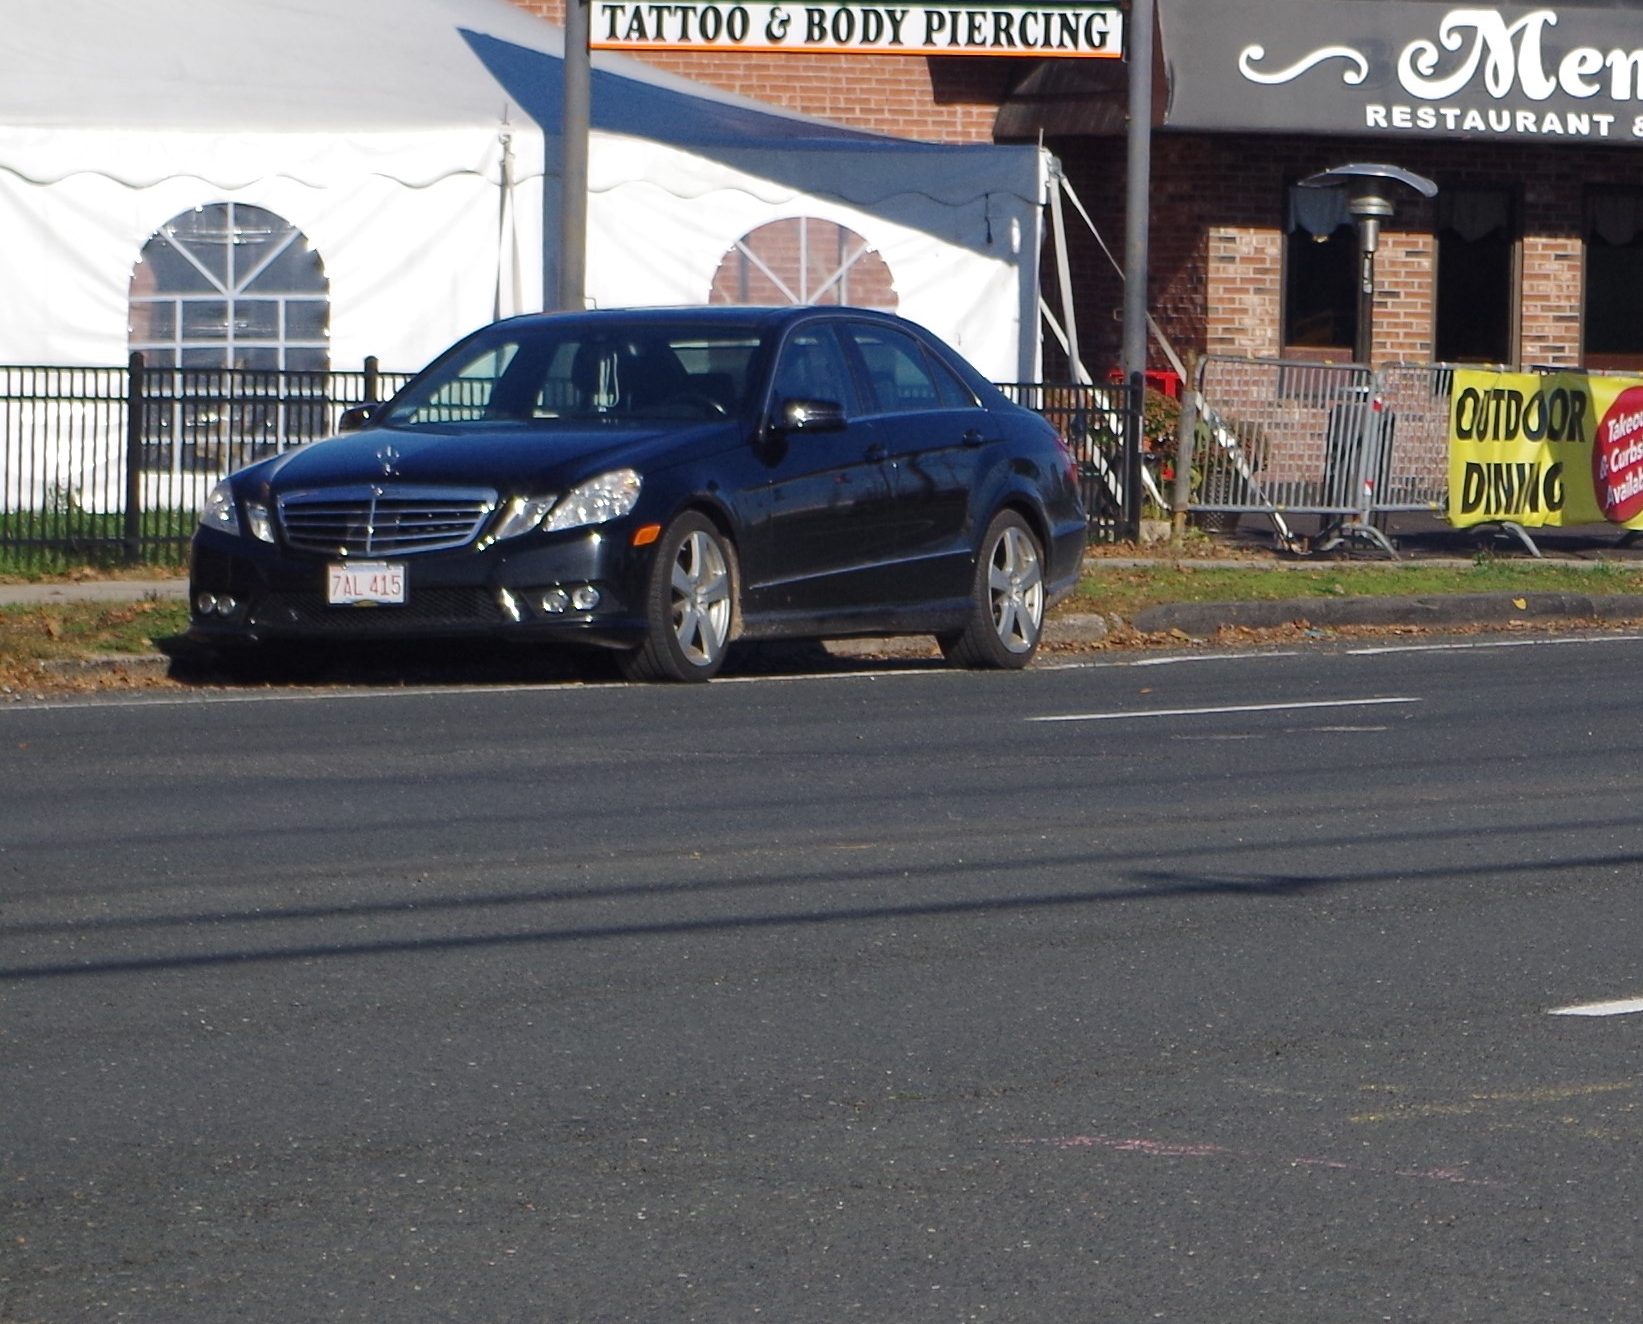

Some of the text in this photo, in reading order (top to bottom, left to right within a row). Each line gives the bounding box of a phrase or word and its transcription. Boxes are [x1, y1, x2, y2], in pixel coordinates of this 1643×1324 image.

[602, 4, 1110, 50] TATTOO & BODY PIERCING
[1366, 104, 1614, 137] RESTAURANT
[1456, 387, 1587, 443] OUTDOOR
[1600, 454, 1609, 480] &
[1461, 461, 1565, 515] DINING
[332, 575, 401, 596] 7AL 415
